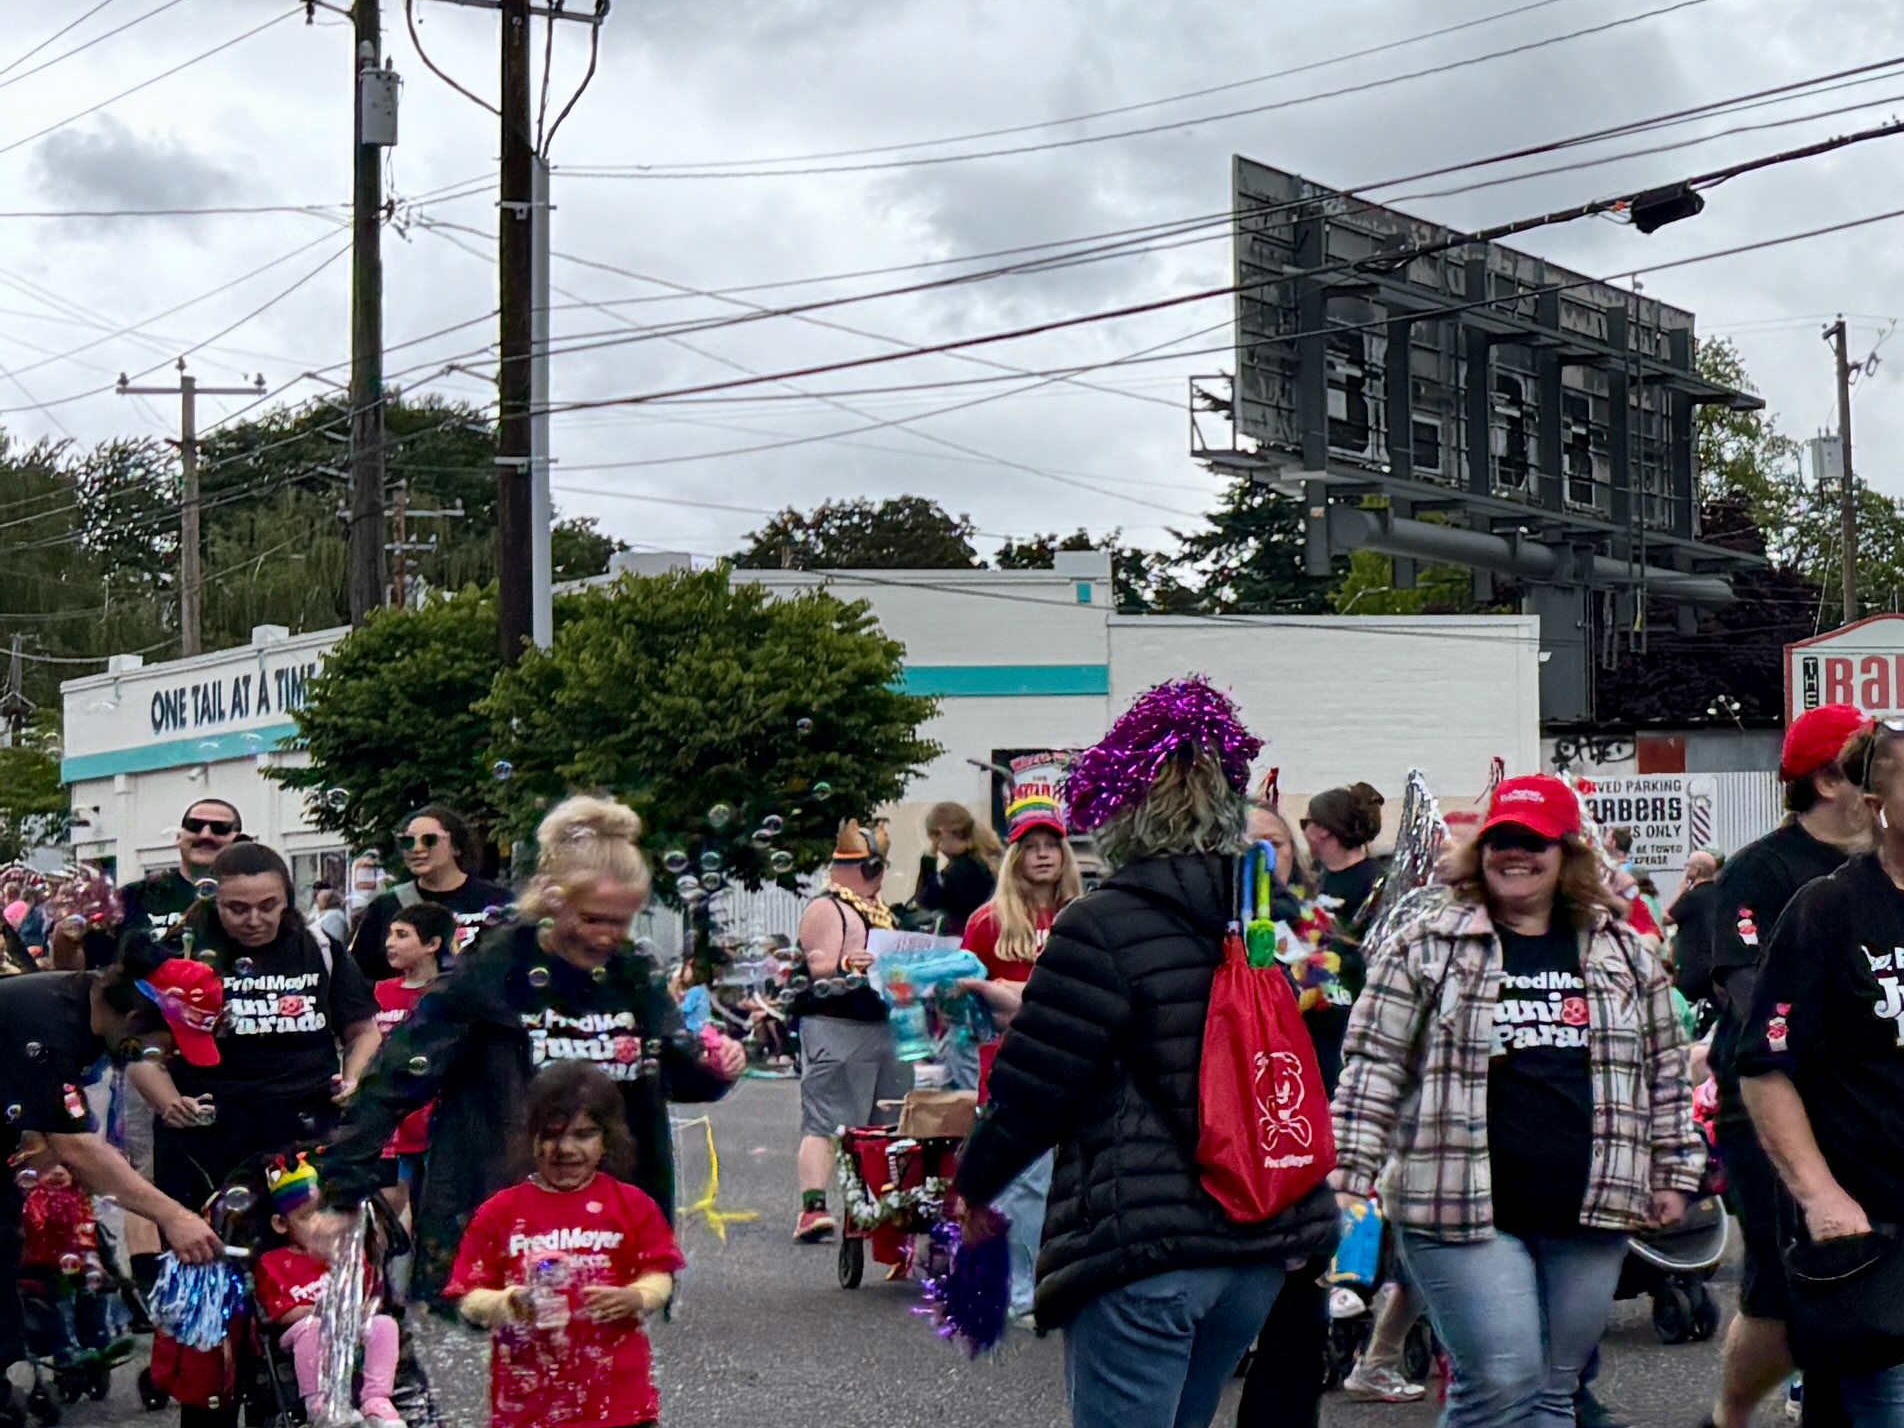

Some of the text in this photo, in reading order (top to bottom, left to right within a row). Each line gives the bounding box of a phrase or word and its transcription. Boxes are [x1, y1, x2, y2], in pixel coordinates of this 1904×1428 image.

[1803, 658, 1818, 708] THE
[151, 687, 187, 735] ONE
[191, 680, 226, 728] TAIL
[230, 673, 252, 720] AT
[257, 671, 270, 716] A
[1626, 779, 1681, 793] PARKING
[1646, 825, 1682, 839] ONLY
